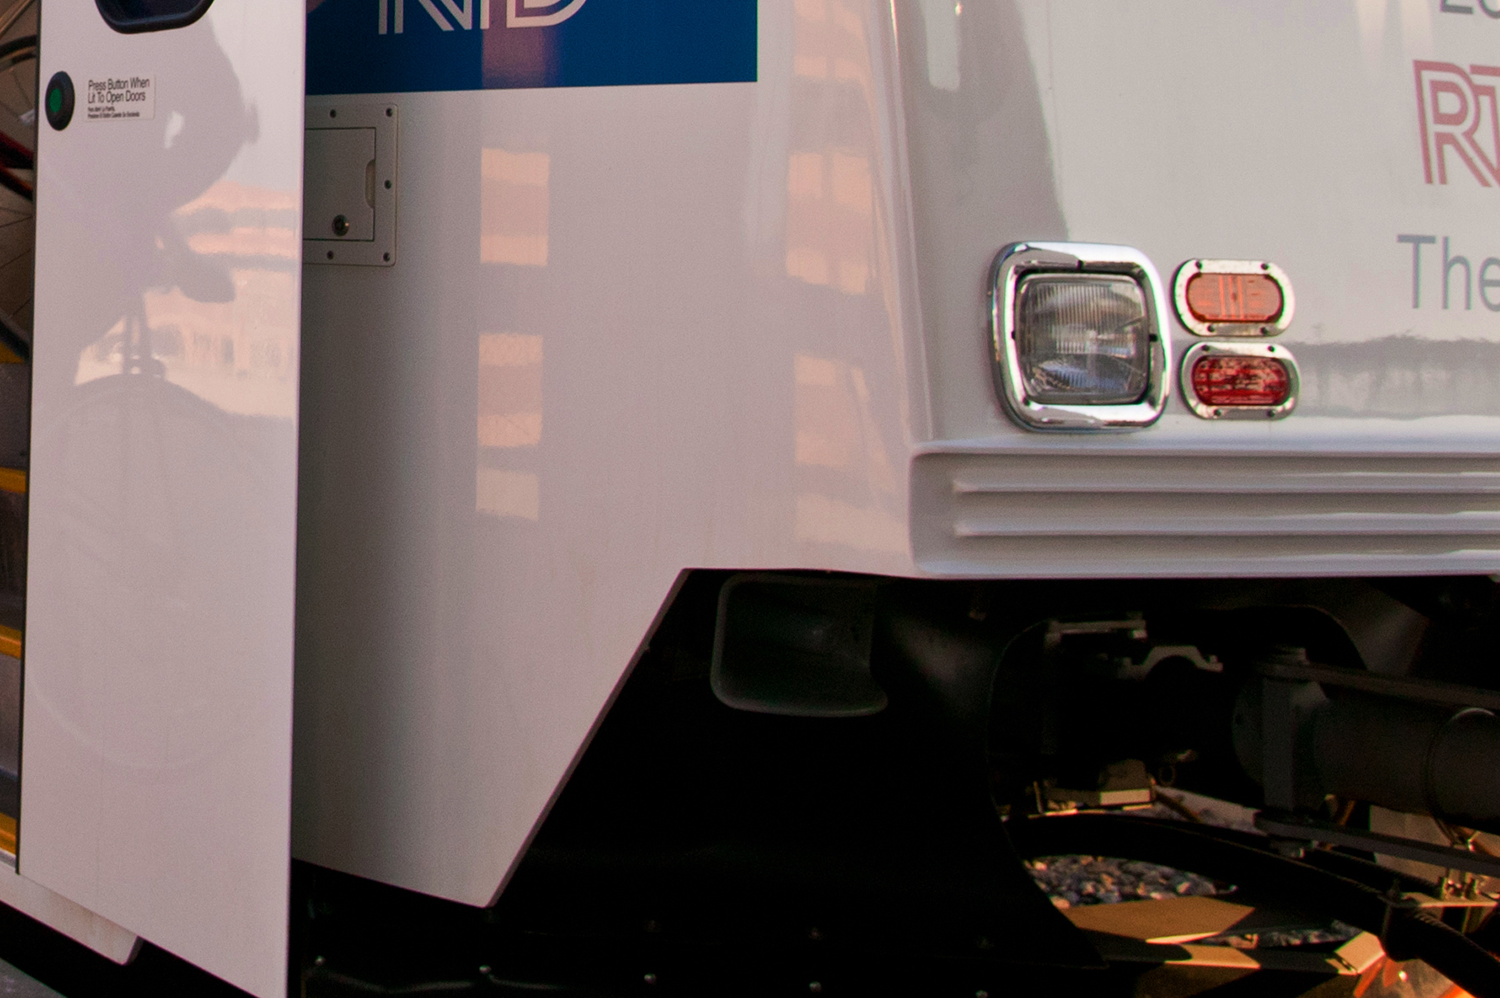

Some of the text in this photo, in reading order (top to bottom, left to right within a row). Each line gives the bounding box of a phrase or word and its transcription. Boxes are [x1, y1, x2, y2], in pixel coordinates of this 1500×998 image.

[87, 76, 151, 92] Press Button When
[87, 89, 146, 106] Lit To Open Doors
